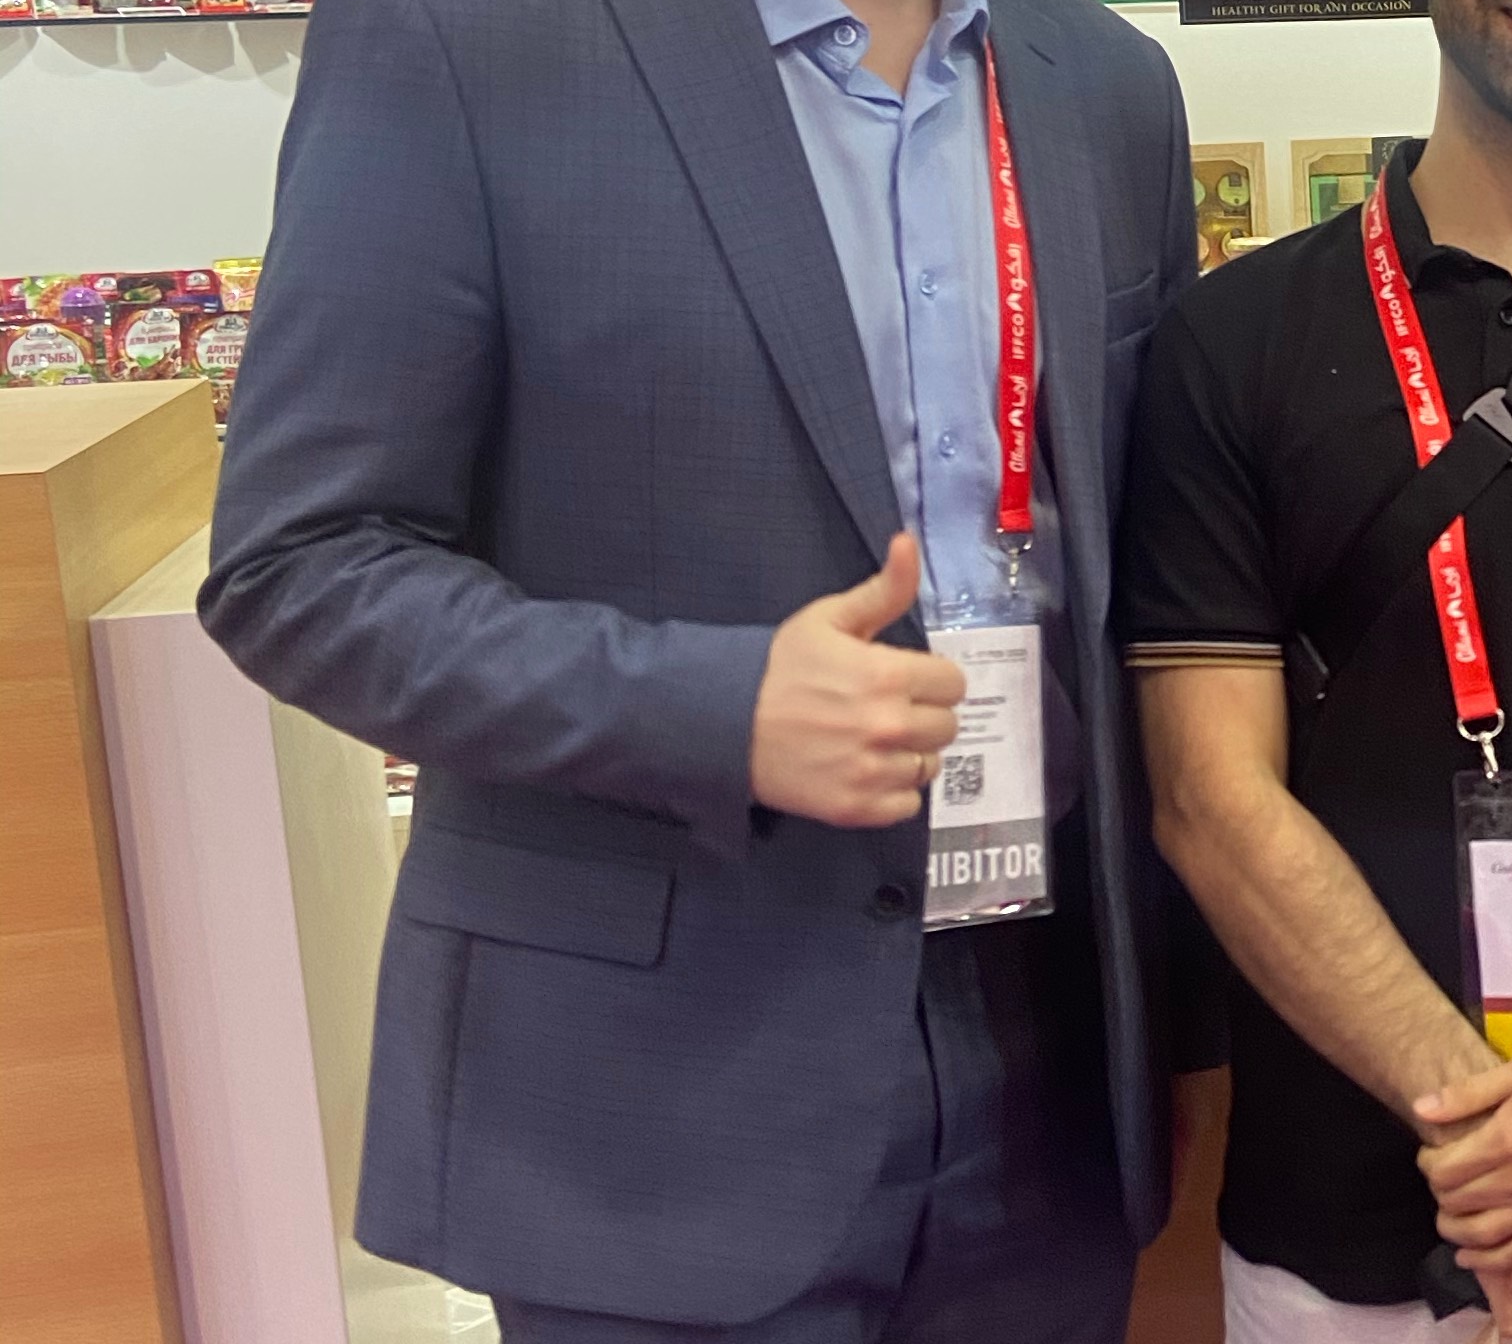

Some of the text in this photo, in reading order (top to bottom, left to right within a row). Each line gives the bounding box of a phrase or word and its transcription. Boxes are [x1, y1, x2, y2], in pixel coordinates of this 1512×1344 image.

[1211, 0, 1413, 17] HEALTHY GIFT FOR ANY OCCASION
[1012, 312, 1025, 359] IFFCO
[1388, 297, 1410, 337] IFFCO
